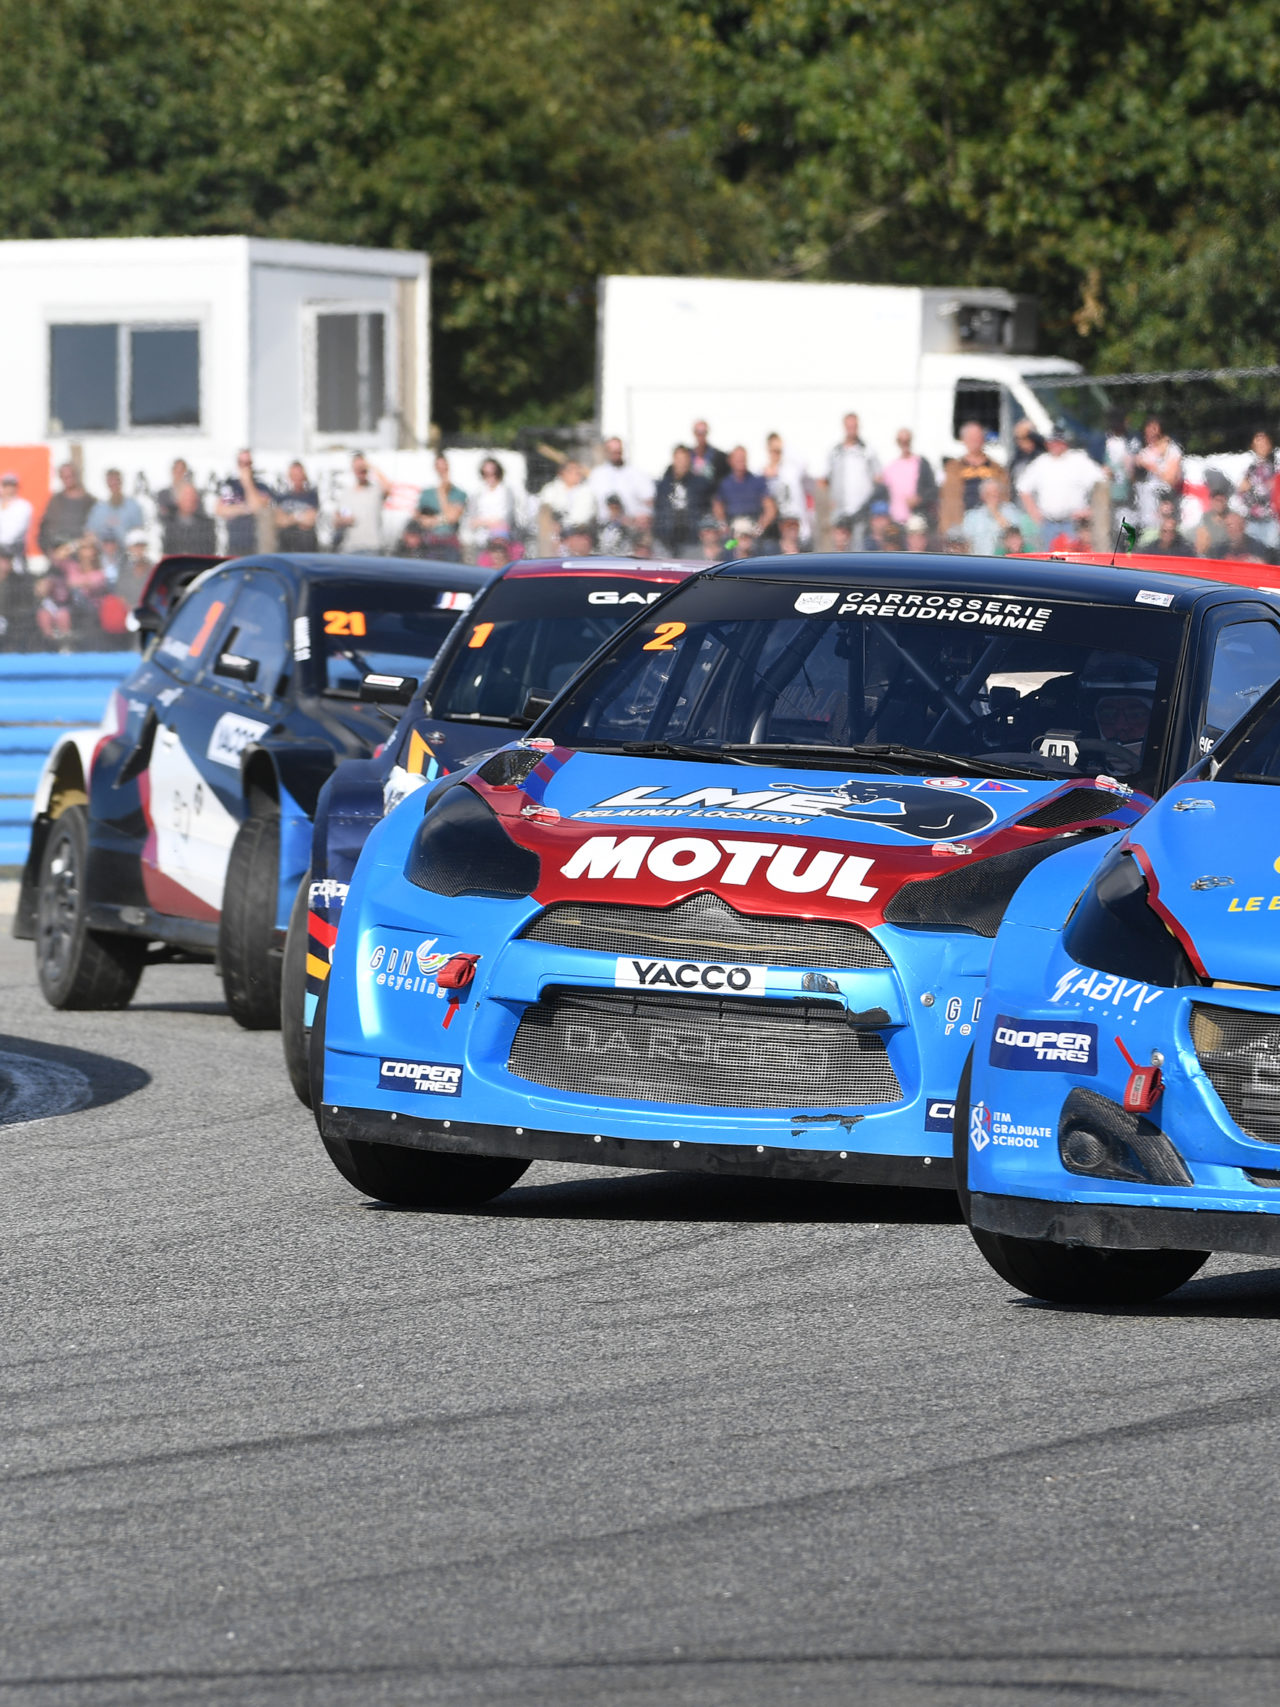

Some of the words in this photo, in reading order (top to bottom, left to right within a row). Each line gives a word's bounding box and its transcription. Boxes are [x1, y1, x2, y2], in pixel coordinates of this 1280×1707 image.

[837, 603, 1048, 632] PREUDHOMME
[846, 592, 1053, 620] CARROSSERIE
[322, 610, 367, 637] 21
[467, 622, 495, 648] 1
[642, 621, 687, 651] 2
[590, 786, 848, 817] LME
[567, 808, 691, 819] DELAUNAY
[688, 808, 815, 826] LOCATION
[558, 835, 880, 903] MOTUL
[1227, 896, 1264, 913] LE
[369, 945, 414, 977] GDN
[631, 961, 752, 990] YACCO
[995, 1026, 1092, 1052] COOPER
[1033, 1047, 1090, 1064] TIRES
[380, 1060, 463, 1083] COOPER
[413, 1079, 460, 1095] TIRES
[992, 1111, 1012, 1123] ITM
[992, 1123, 1052, 1138] GRADUATE
[992, 1135, 1040, 1149] SCHOOL
